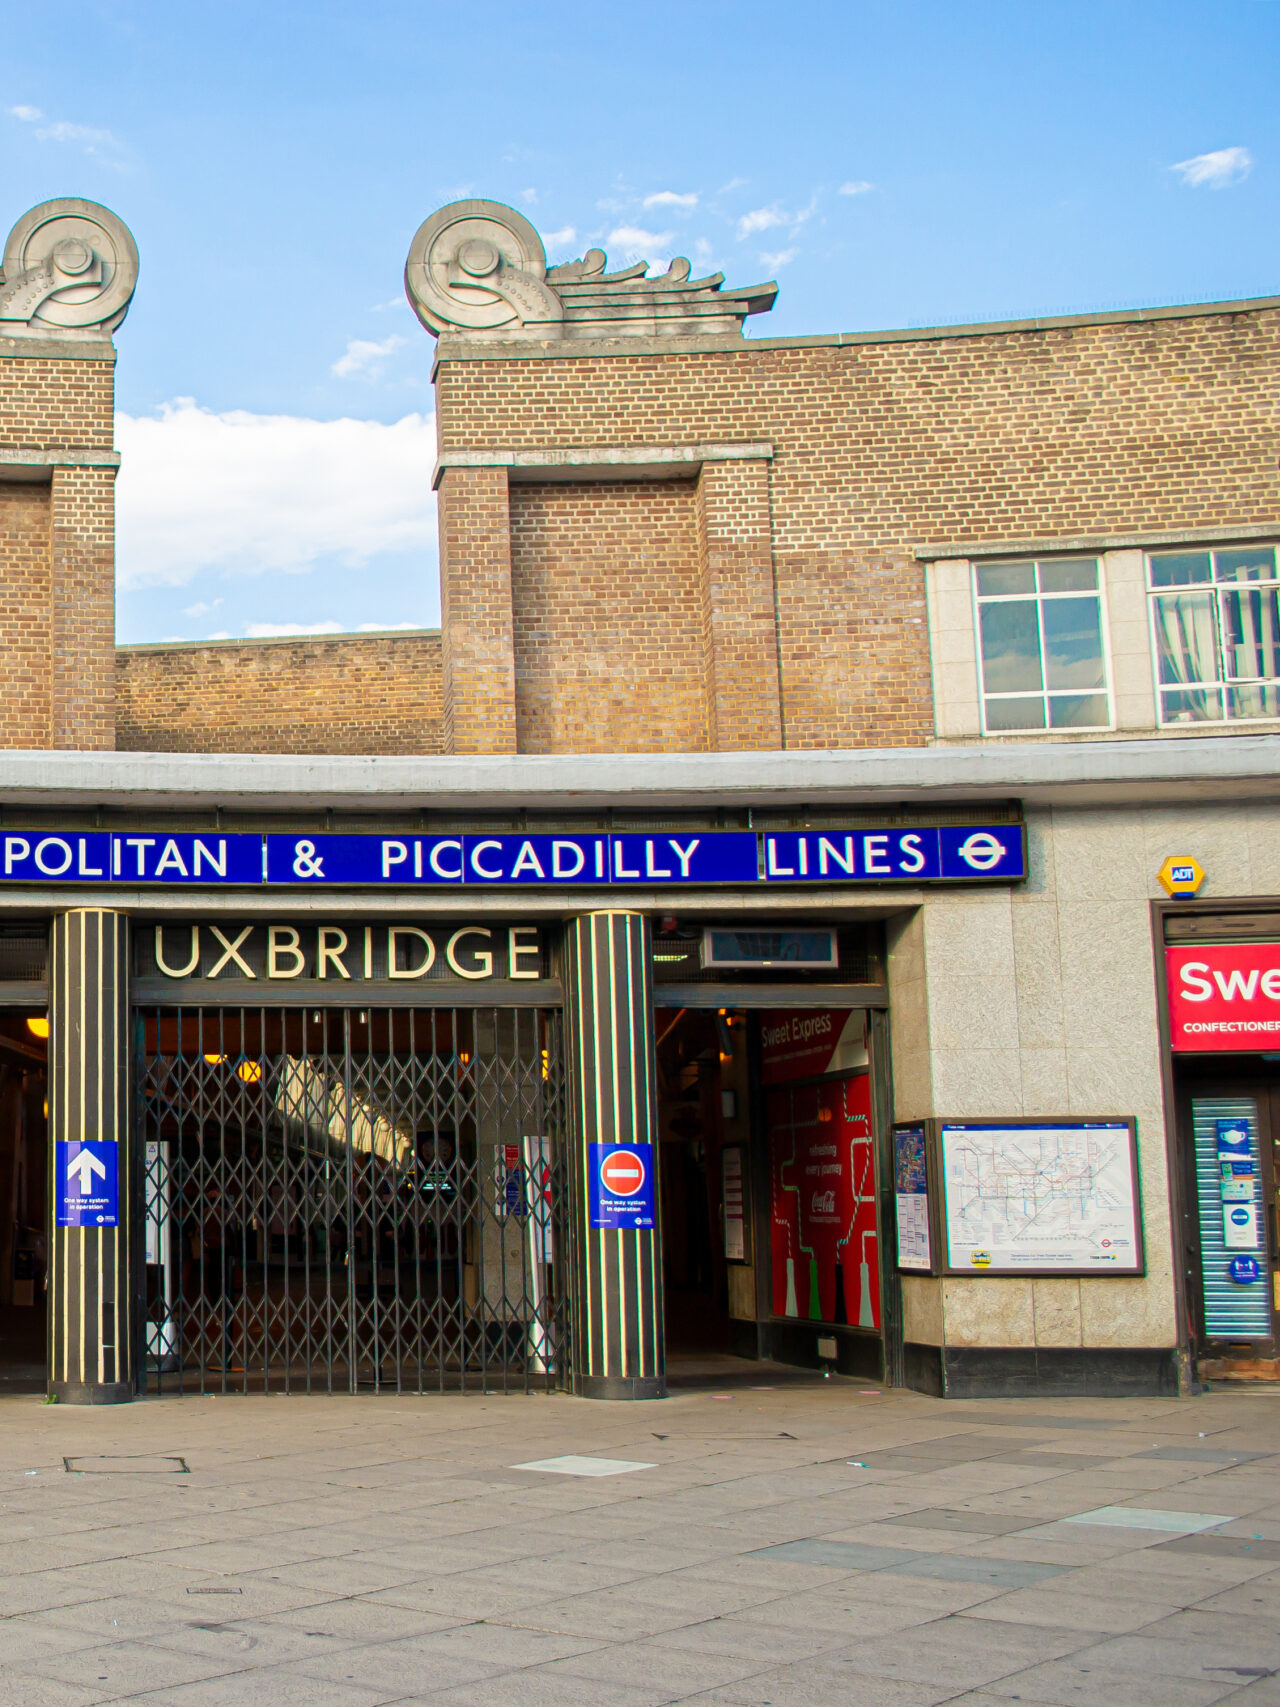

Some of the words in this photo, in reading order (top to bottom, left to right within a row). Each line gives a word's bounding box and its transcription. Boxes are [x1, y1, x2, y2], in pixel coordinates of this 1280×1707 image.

[293, 839, 325, 878] &
[381, 839, 700, 879] PICCADILLY
[767, 834, 925, 876] LINES
[1172, 867, 1194, 881] ADT
[154, 925, 540, 980] UXBRIDGE
[1180, 962, 1280, 1002] Swe
[761, 1020, 791, 1047] Sweet
[791, 1013, 831, 1041] Express
